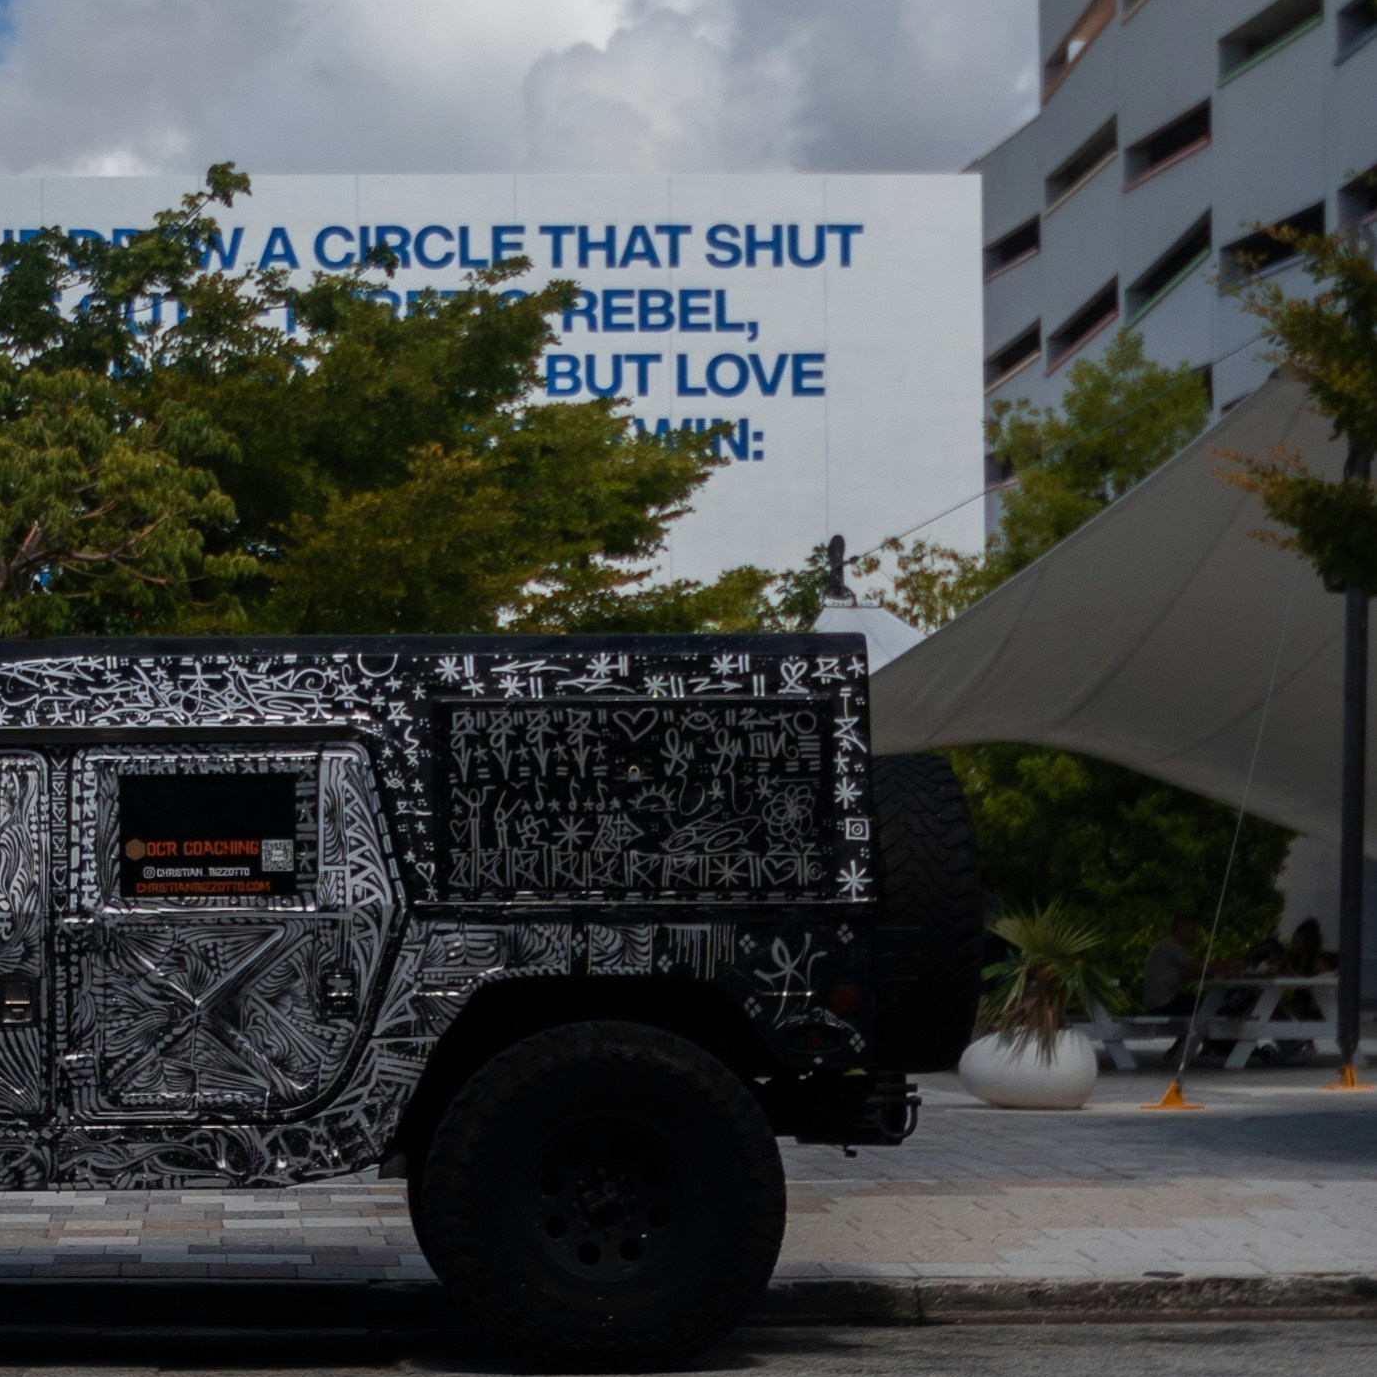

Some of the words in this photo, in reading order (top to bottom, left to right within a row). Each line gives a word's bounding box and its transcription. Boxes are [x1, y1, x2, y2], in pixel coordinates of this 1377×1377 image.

[258, 226, 300, 270] A
[313, 224, 526, 270] CIRCLE
[539, 225, 692, 269] THAT
[705, 224, 864, 268] SHUT
[562, 288, 759, 342] REBEL,
[546, 353, 662, 398] BUT
[677, 353, 826, 398] LOVE
[146, 841, 178, 857] OCR
[183, 840, 260, 857] COACHING
